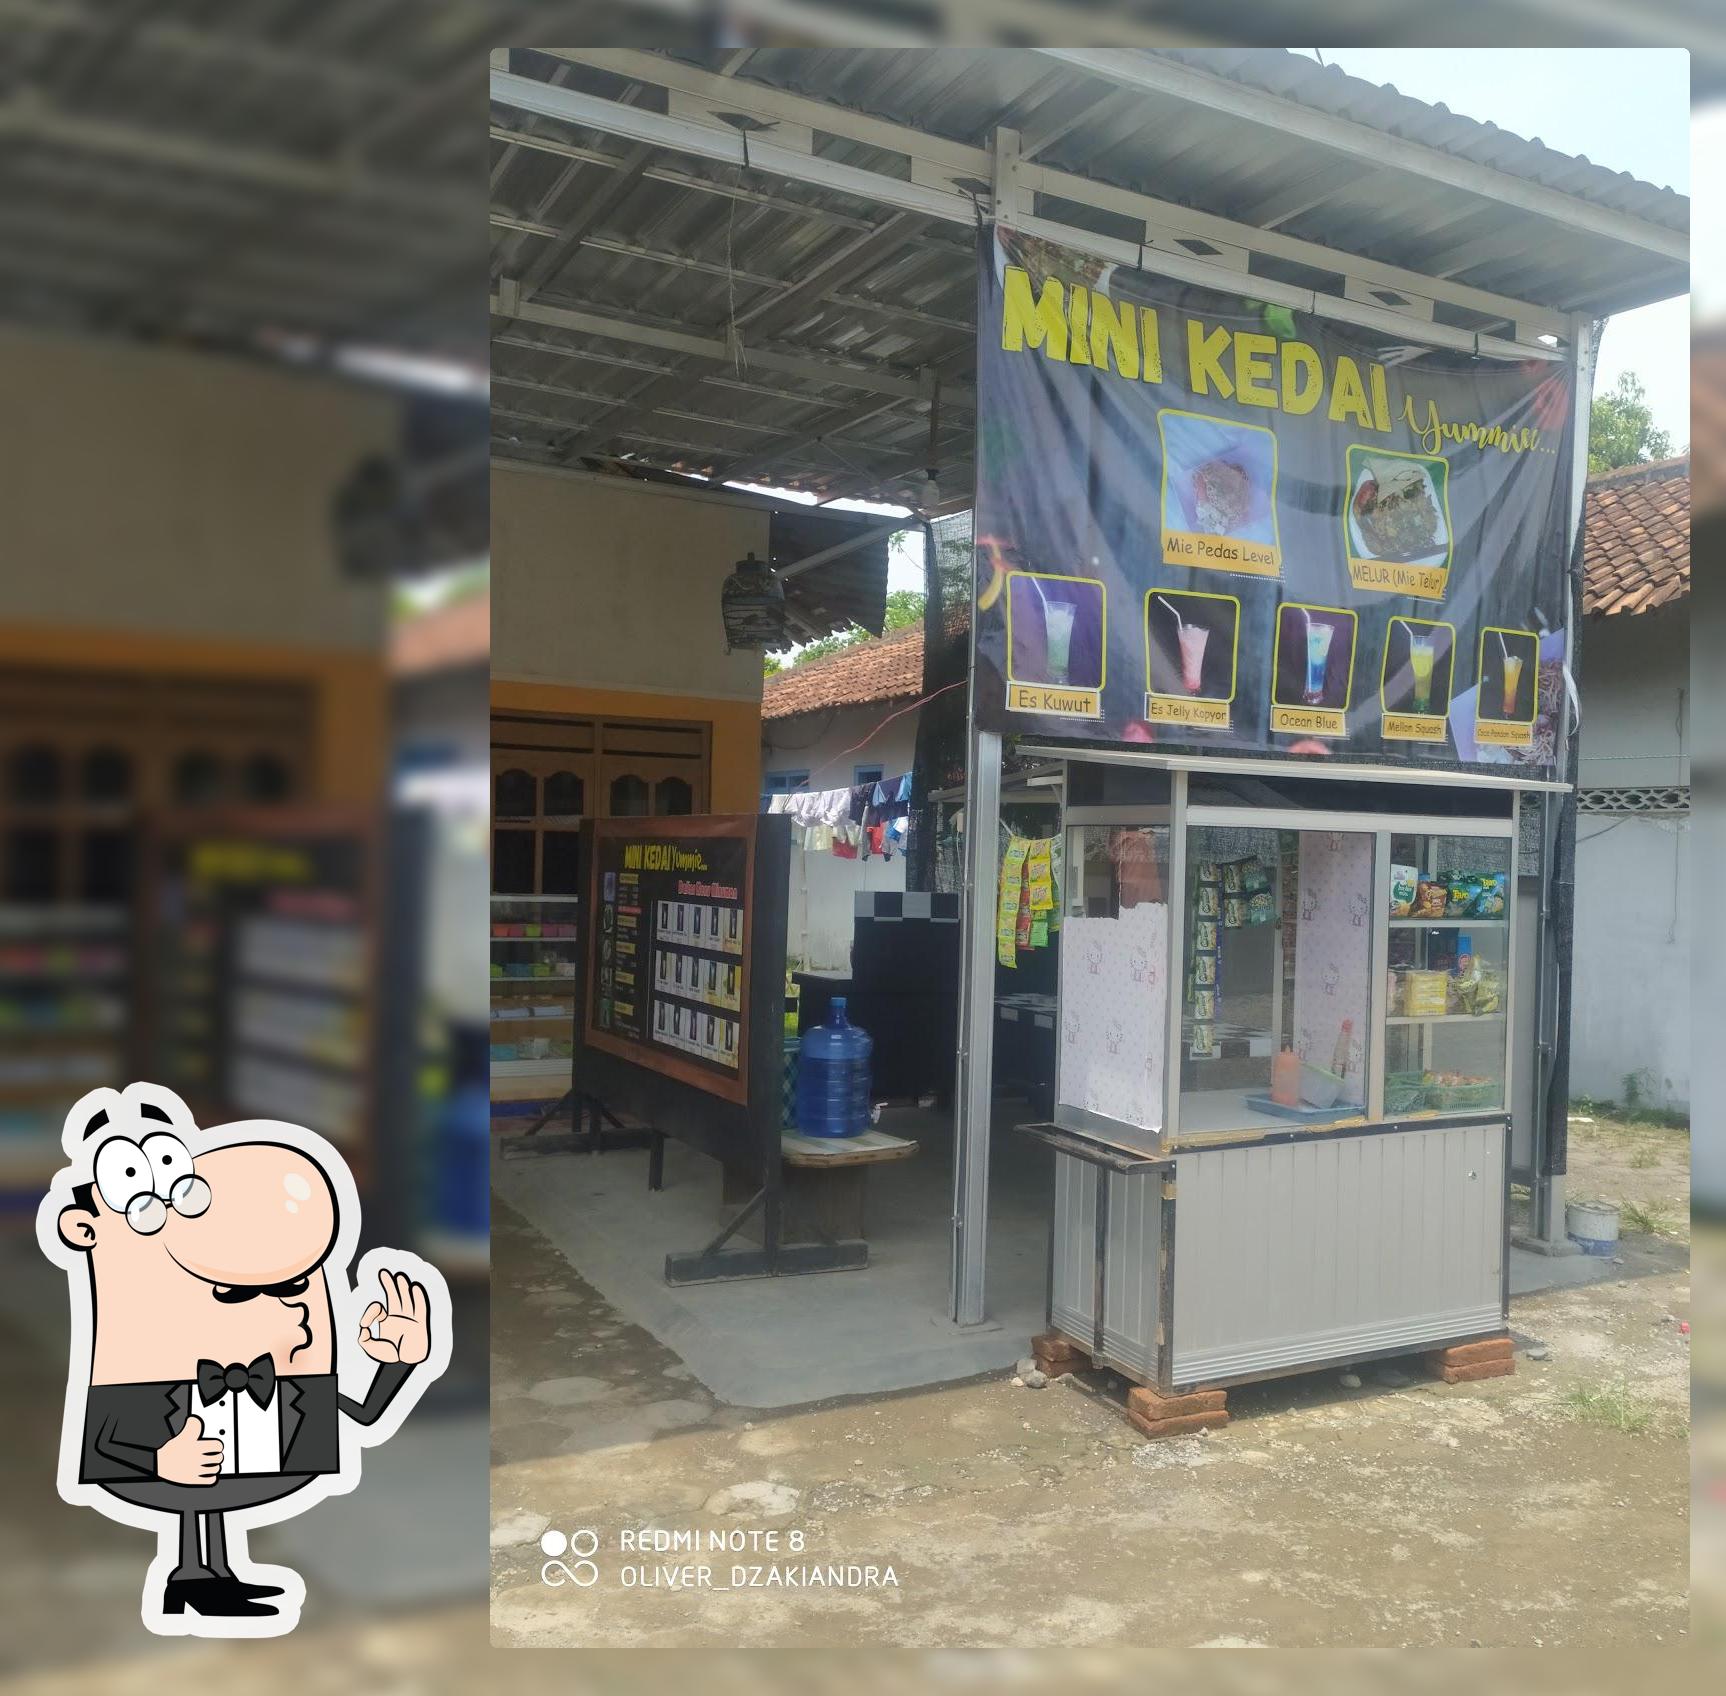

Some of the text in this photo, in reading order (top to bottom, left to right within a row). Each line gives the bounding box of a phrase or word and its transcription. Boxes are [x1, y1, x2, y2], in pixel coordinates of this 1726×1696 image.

[1001, 265, 1392, 433] MINI KEDAI
[1167, 537, 1274, 565] Mie Pedas Level
[1353, 565, 1390, 583] MELUR
[1392, 569, 1416, 588] (Mie
[1019, 690, 1092, 713] Es Kuwut
[1151, 702, 1227, 722] Es Jelly Kopyor
[1280, 713, 1338, 729] Ocean Blue
[624, 844, 642, 870] MINI
[643, 845, 671, 871] KEDAI
